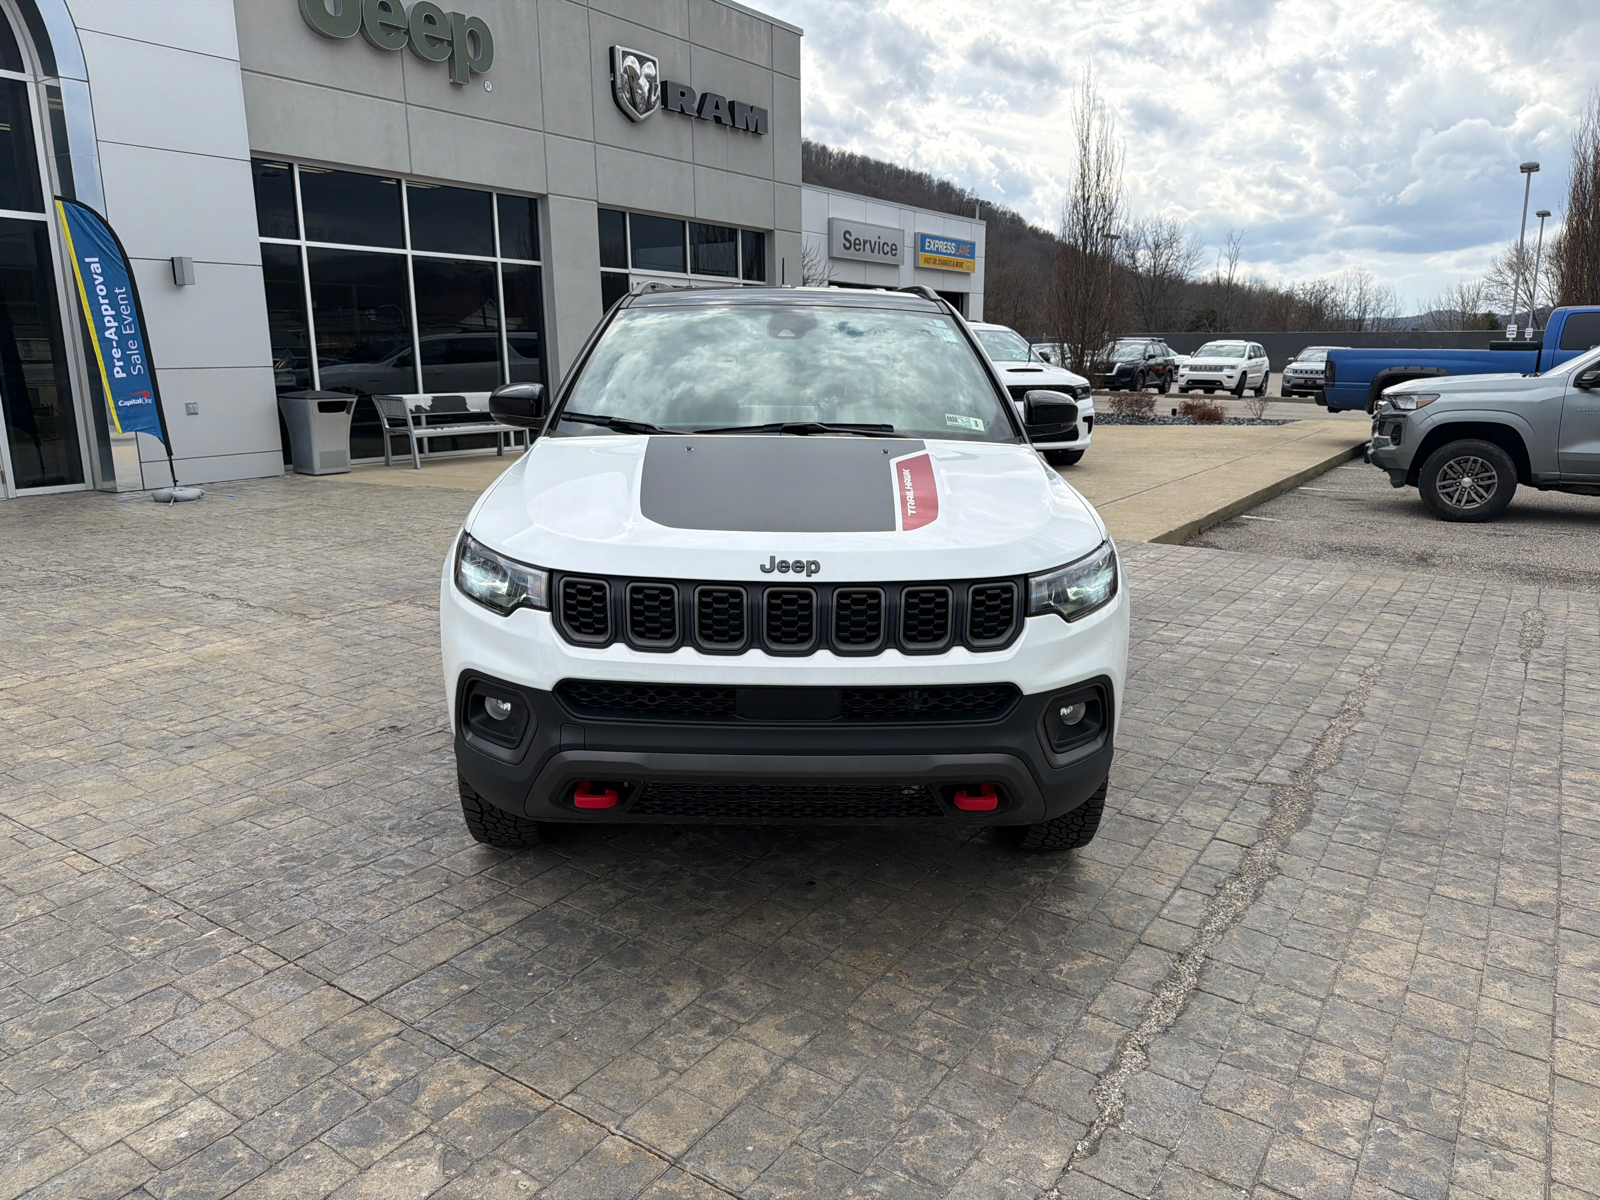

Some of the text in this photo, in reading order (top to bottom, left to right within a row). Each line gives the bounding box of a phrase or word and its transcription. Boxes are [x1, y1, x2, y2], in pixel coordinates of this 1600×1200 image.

[660, 80, 769, 136] RAM
[842, 229, 898, 257] Service
[84, 257, 127, 379] Pre-Approval
[113, 286, 144, 376] Sale Event
[902, 468, 917, 517] TRAILHAWK
[759, 555, 821, 577] Jeep
